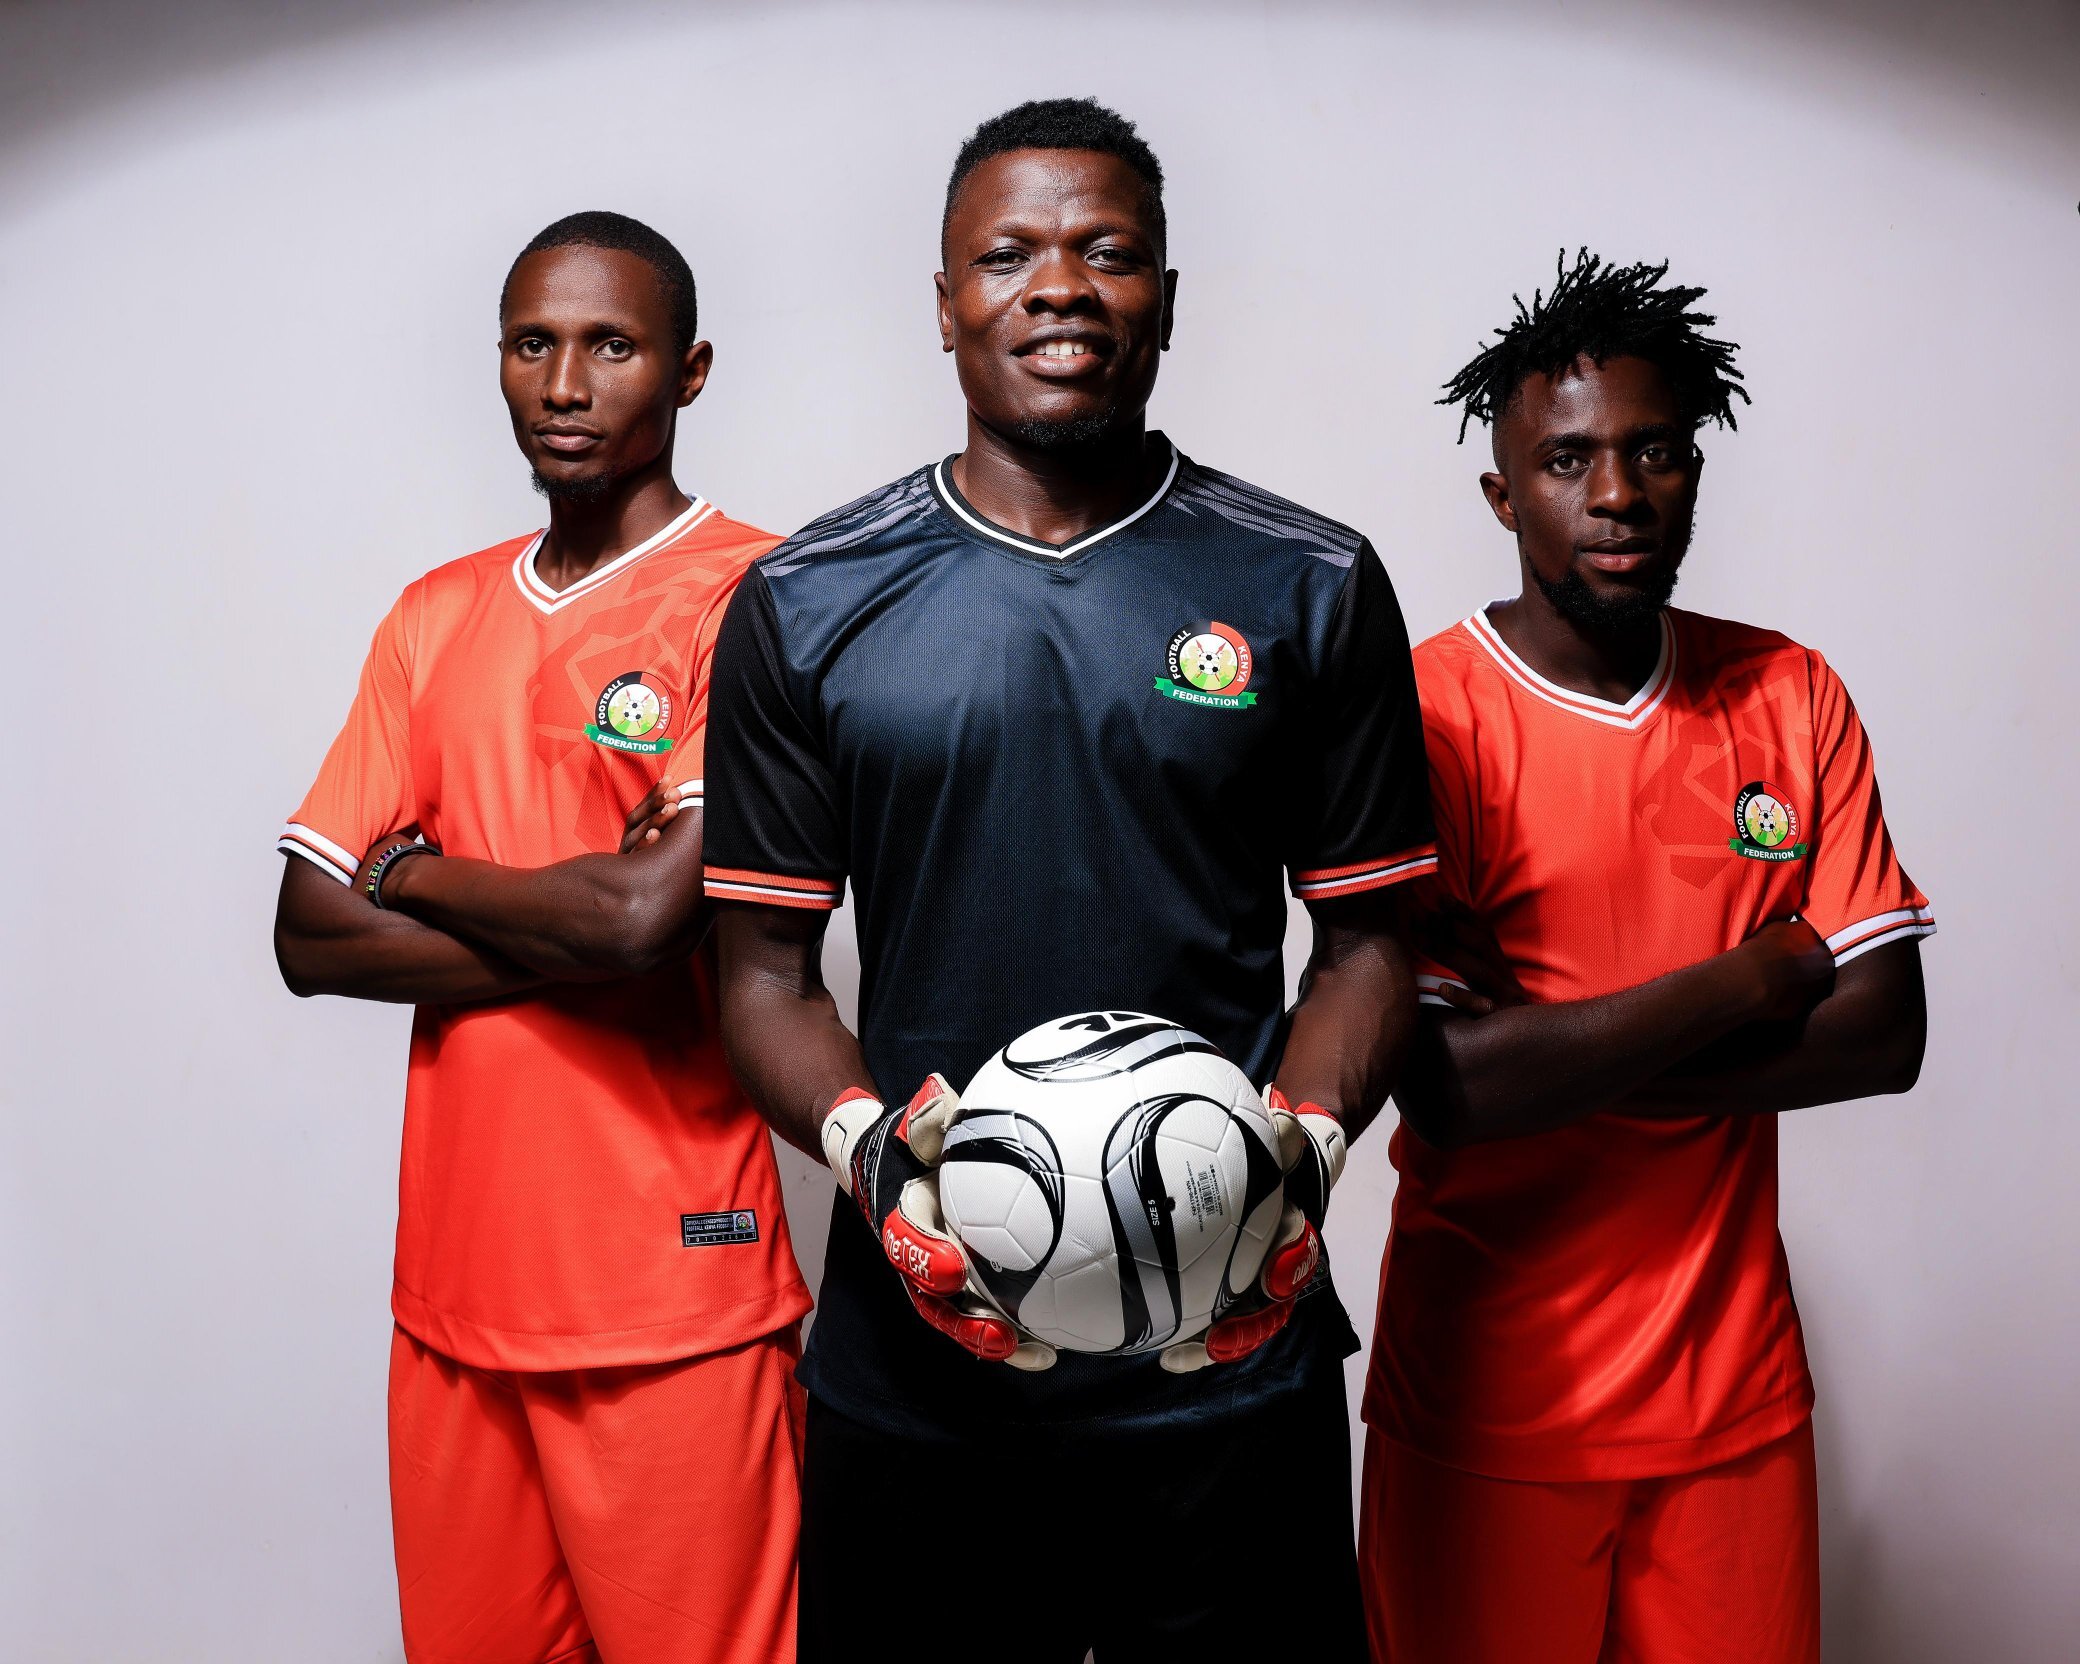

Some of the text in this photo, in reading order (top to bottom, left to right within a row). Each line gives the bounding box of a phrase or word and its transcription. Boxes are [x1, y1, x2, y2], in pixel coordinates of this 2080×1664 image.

[1168, 630, 1191, 680] FOOTBALL
[1237, 645, 1249, 683] KENYA
[598, 680, 624, 726] FOOTBALL
[656, 696, 669, 730] KENYA
[1173, 689, 1239, 707] FEDERATION
[596, 734, 656, 752] FEDERATION
[1736, 791, 1751, 839] FOOTBALL
[1784, 803, 1797, 836] KENYA
[1743, 848, 1795, 860] FEDERATION
[1149, 1206, 1160, 1226] SIZE
